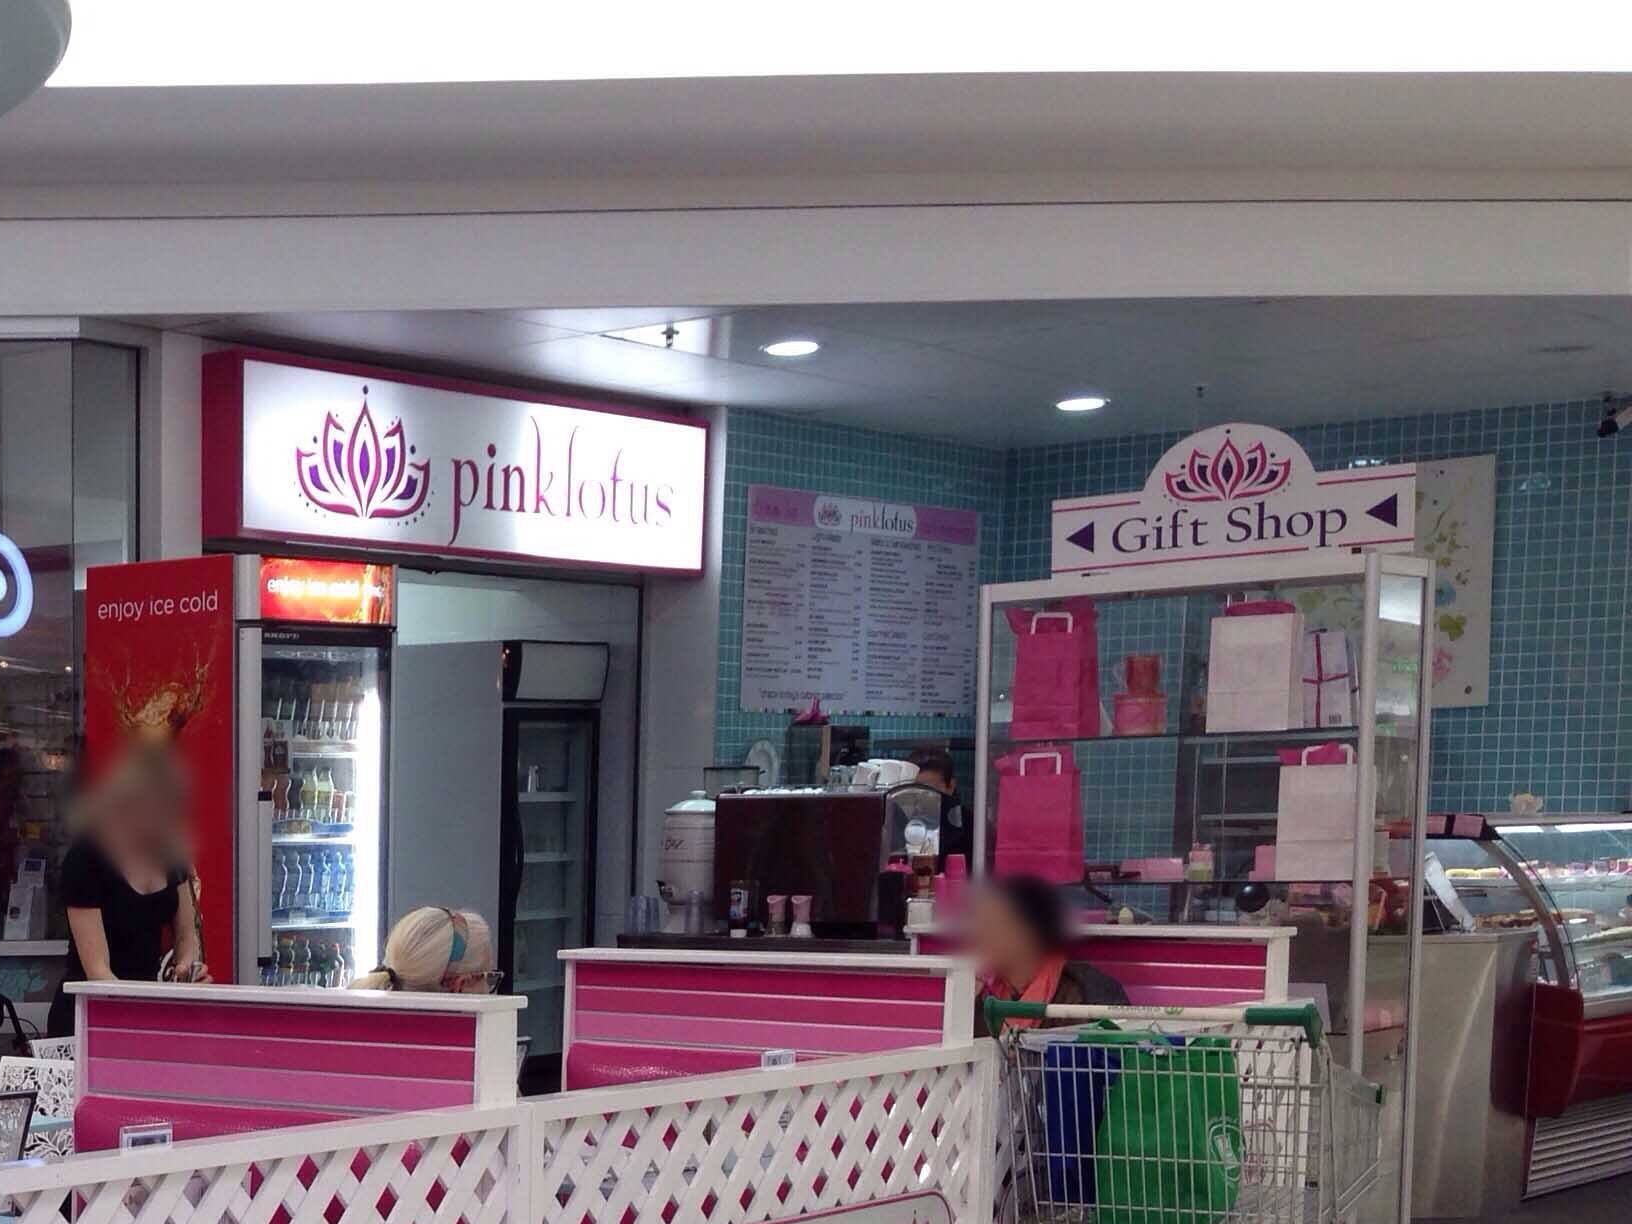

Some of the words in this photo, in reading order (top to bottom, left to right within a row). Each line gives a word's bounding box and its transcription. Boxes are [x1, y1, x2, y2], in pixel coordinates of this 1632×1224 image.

[449, 415, 675, 546] pinklotus
[850, 502, 914, 536] pinklotus
[1112, 508, 1209, 554] Gift
[1226, 501, 1348, 548] Shop
[97, 598, 145, 622] enjoy
[149, 595, 175, 616] ice
[179, 589, 218, 613] cold
